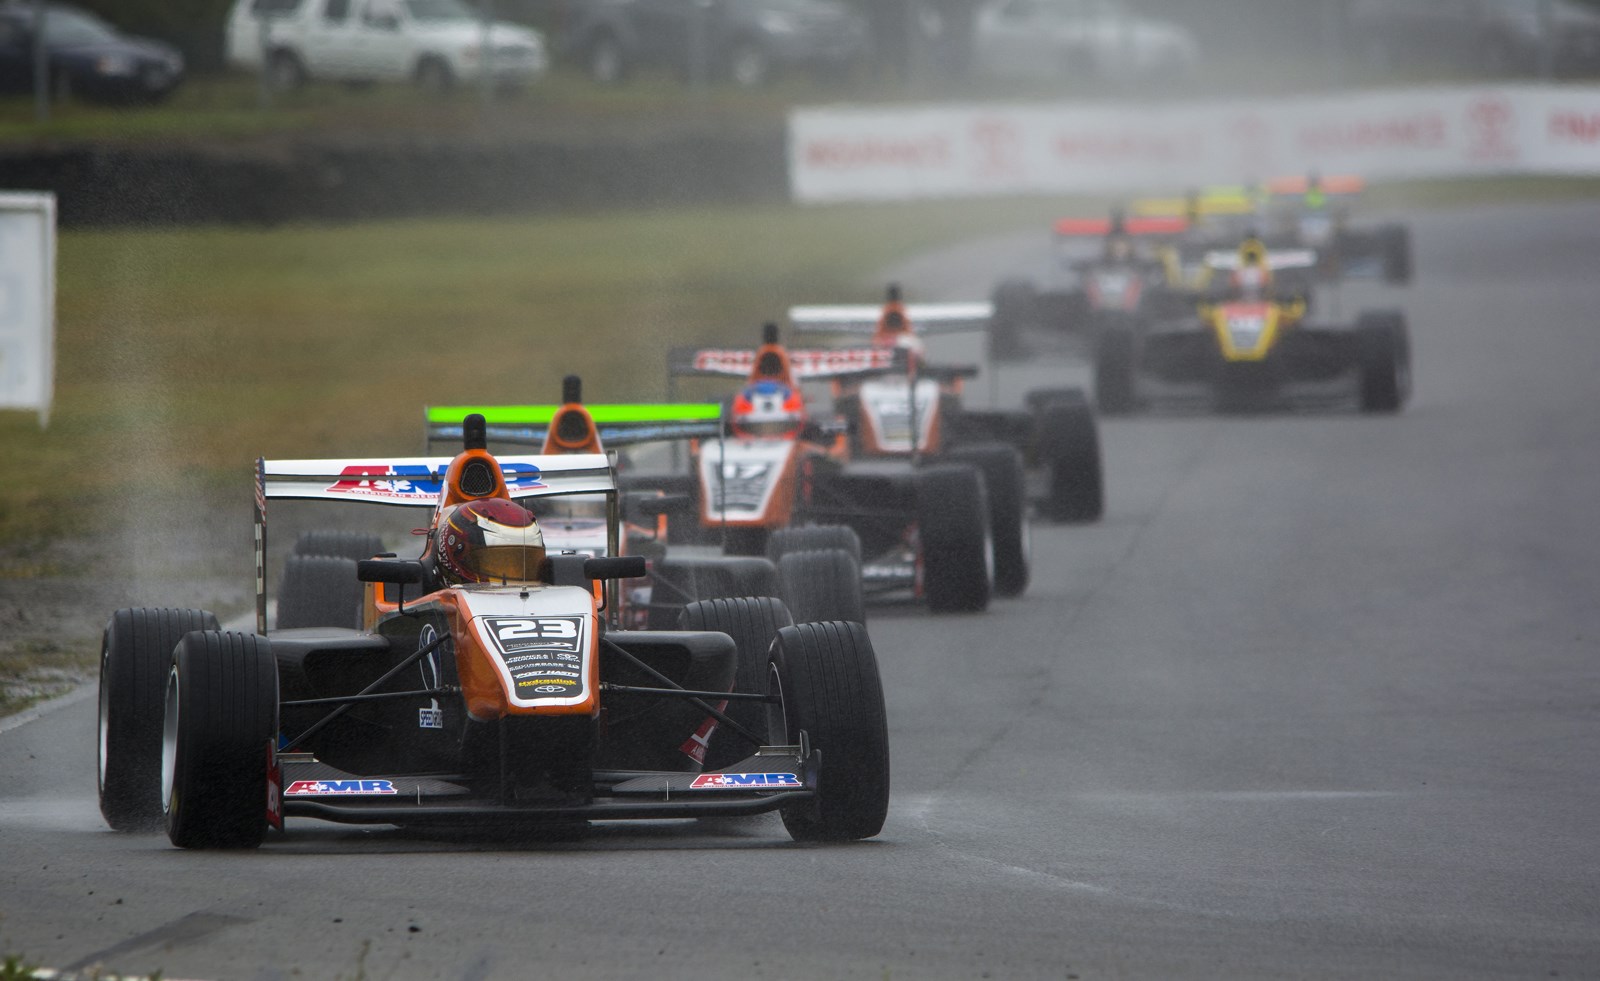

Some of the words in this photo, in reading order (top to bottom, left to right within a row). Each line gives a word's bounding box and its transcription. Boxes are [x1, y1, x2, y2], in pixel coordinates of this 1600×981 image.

[722, 463, 768, 480] 17
[346, 490, 407, 499] AMERICAN
[496, 619, 577, 640] 23
[691, 774, 800, 785] AMR
[286, 780, 396, 793] AMR
